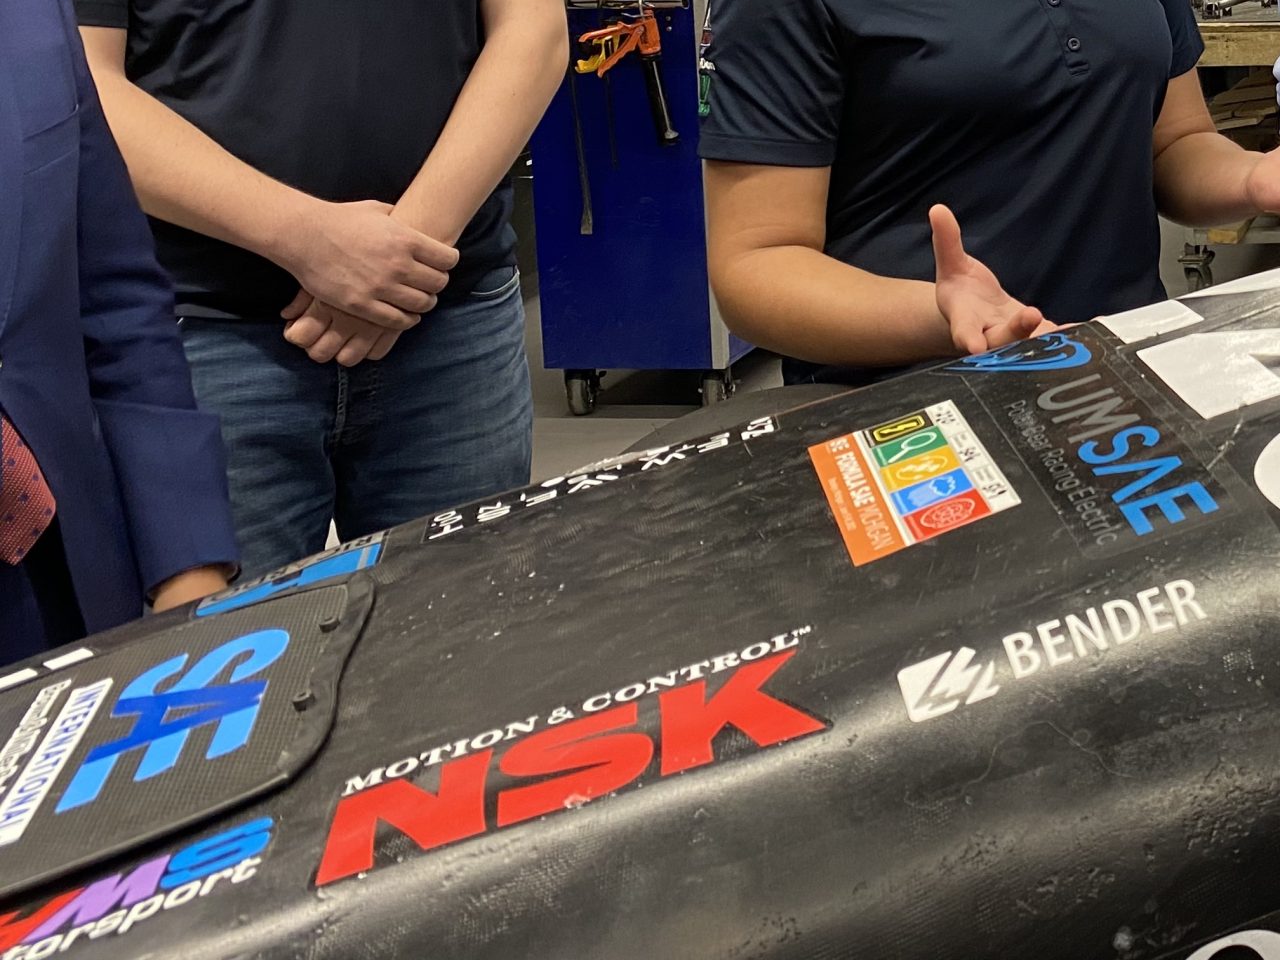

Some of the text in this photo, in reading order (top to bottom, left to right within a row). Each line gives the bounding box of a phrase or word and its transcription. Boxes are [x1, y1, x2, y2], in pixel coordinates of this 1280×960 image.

[1040, 447, 1081, 491] Racing
[1067, 486, 1121, 546] Electric
[1002, 579, 1208, 679] BENDER
[314, 650, 828, 887] NSK
[341, 715, 538, 798] MOTION
[547, 705, 575, 725] &
